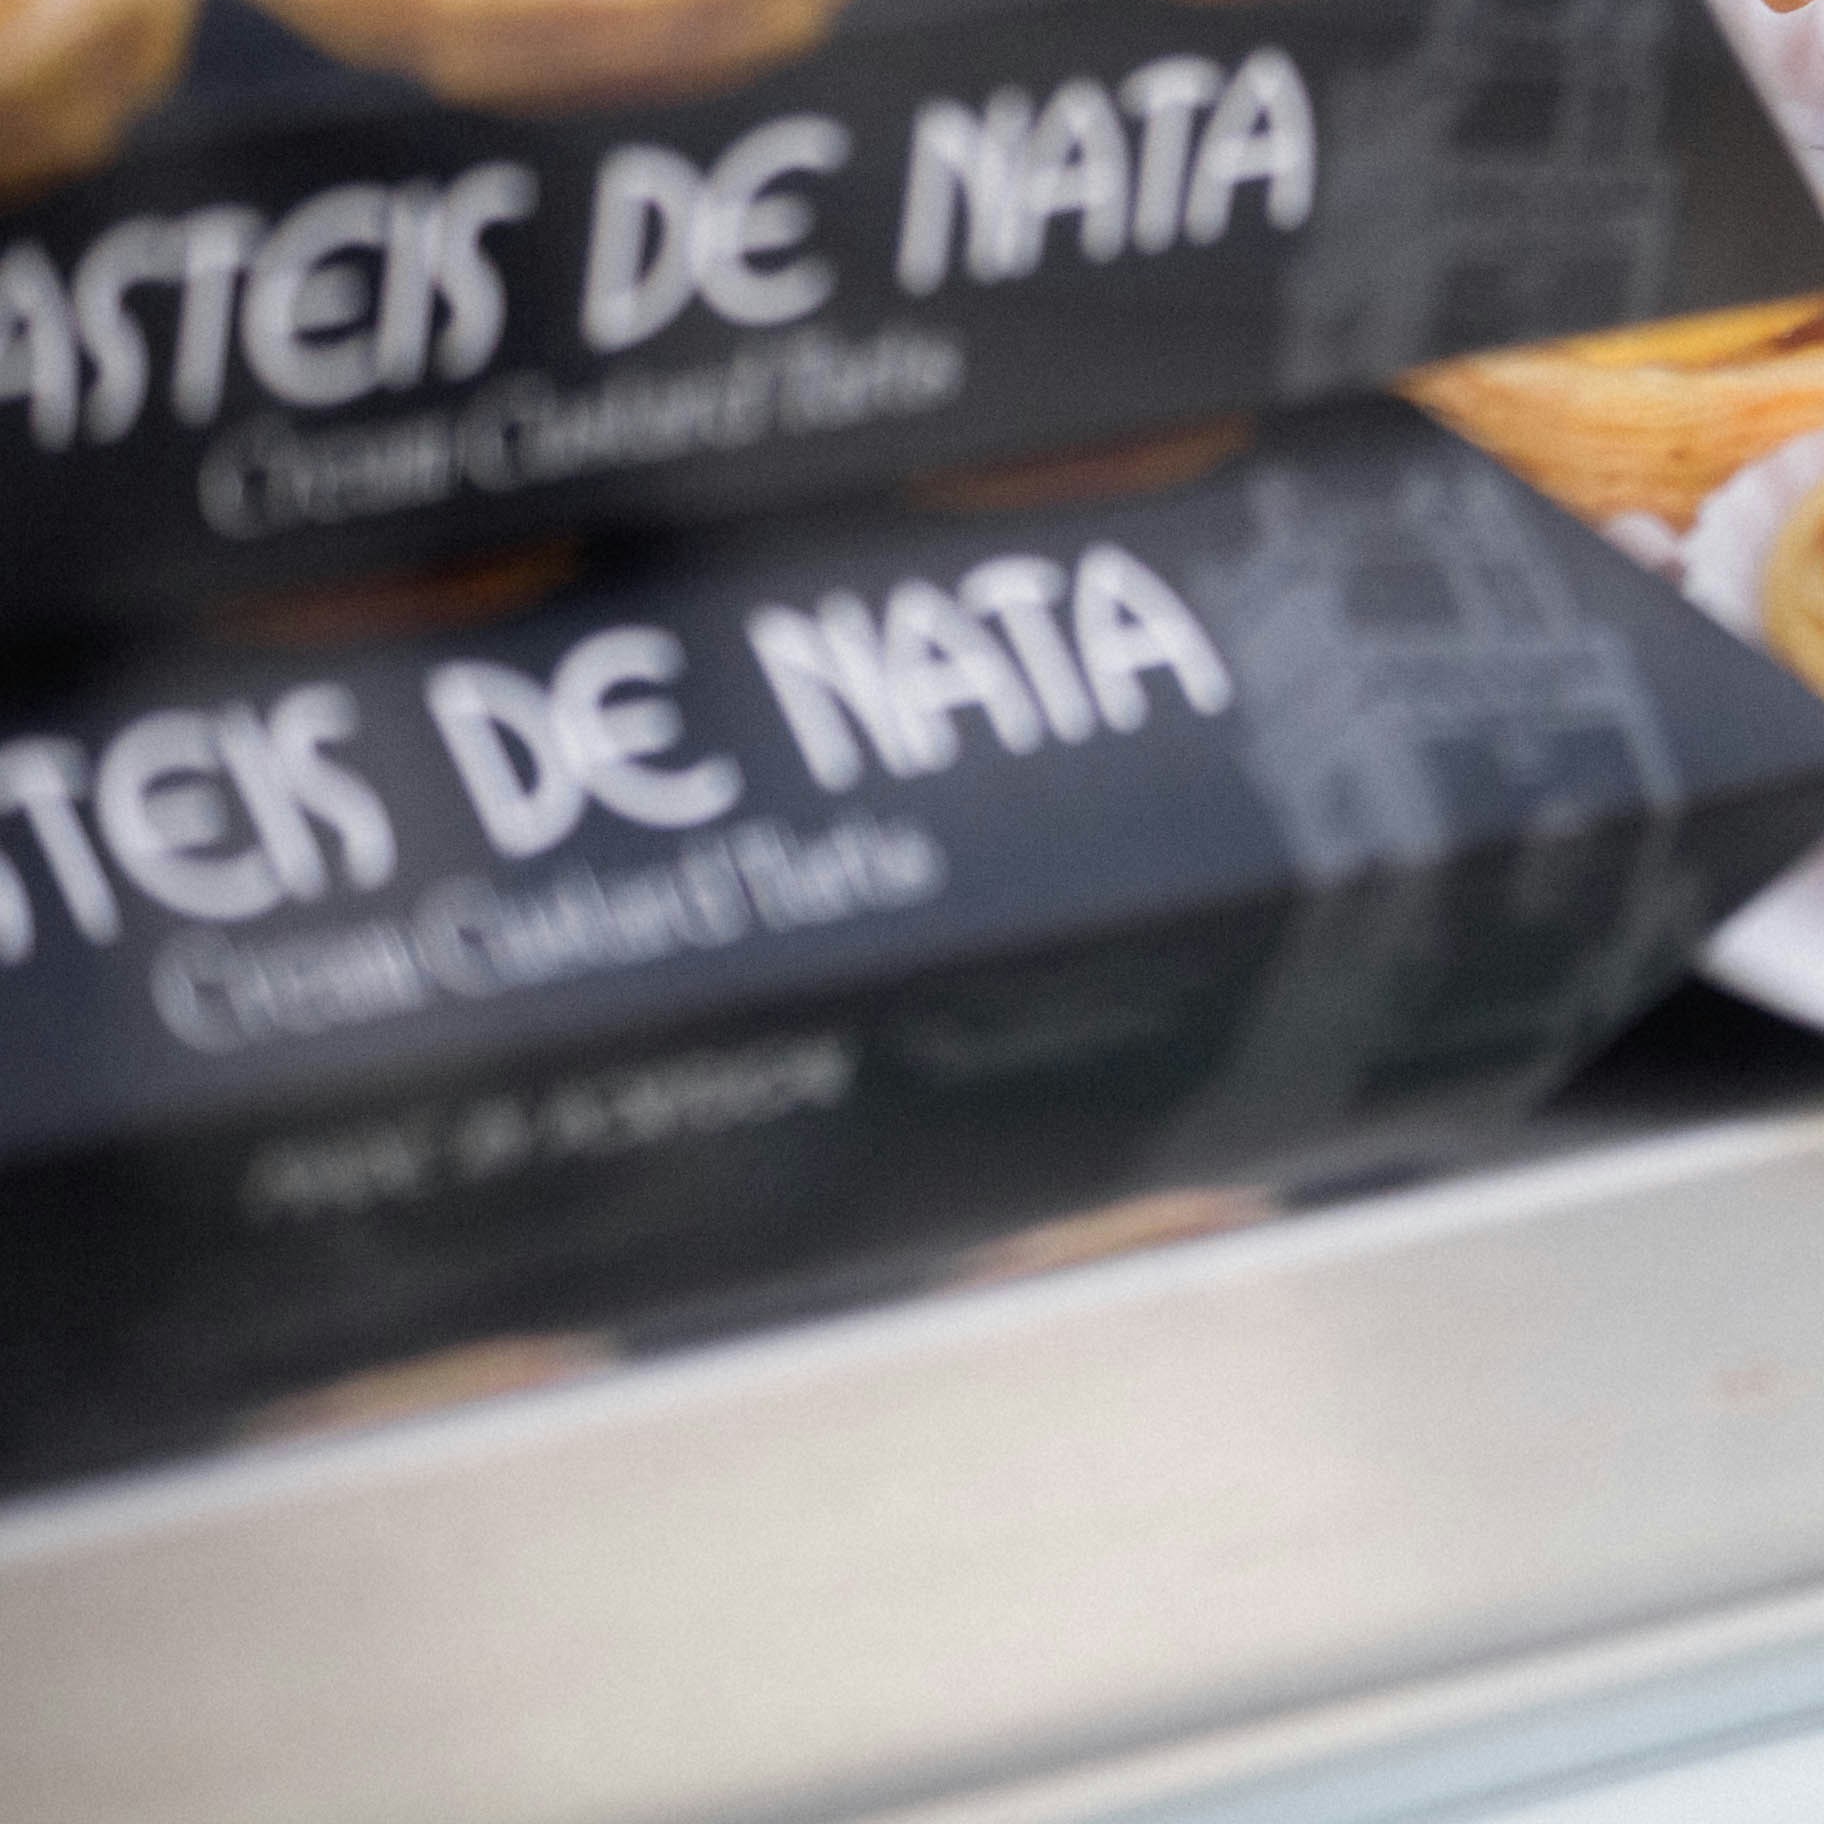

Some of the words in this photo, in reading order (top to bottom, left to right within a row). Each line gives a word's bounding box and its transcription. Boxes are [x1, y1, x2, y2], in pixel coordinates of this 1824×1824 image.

[579, 113, 856, 352] DE
[894, 46, 1317, 296] NATA
[422, 625, 748, 860] DE
[745, 543, 1235, 792] NATA
